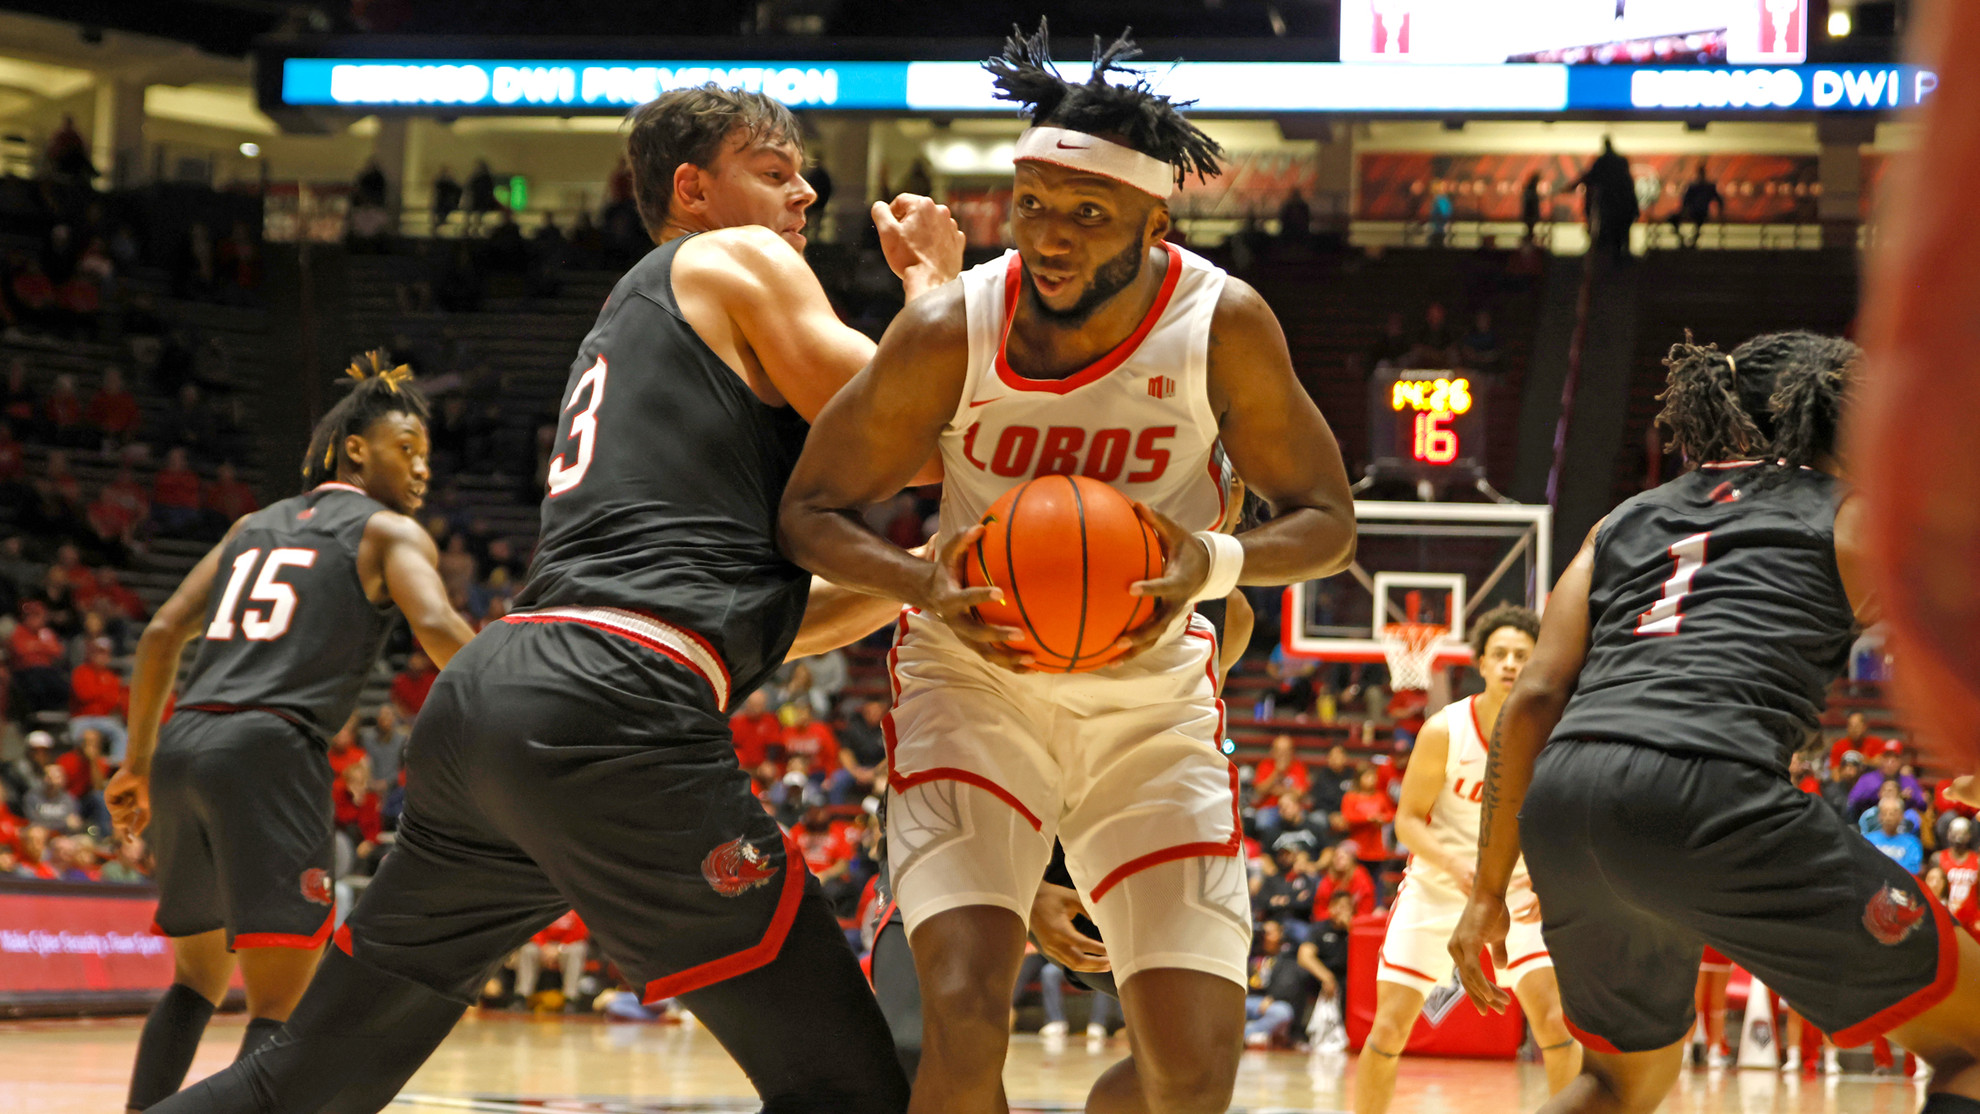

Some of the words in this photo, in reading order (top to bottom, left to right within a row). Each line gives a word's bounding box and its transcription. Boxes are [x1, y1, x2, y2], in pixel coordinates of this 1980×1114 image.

[492, 66, 575, 103] DWI
[1813, 70, 1899, 107] DWI
[548, 353, 608, 498] 3
[963, 421, 1177, 484] LOBOS
[1414, 409, 1459, 465] 16
[206, 547, 318, 641] 15
[1633, 531, 1712, 636] 1
